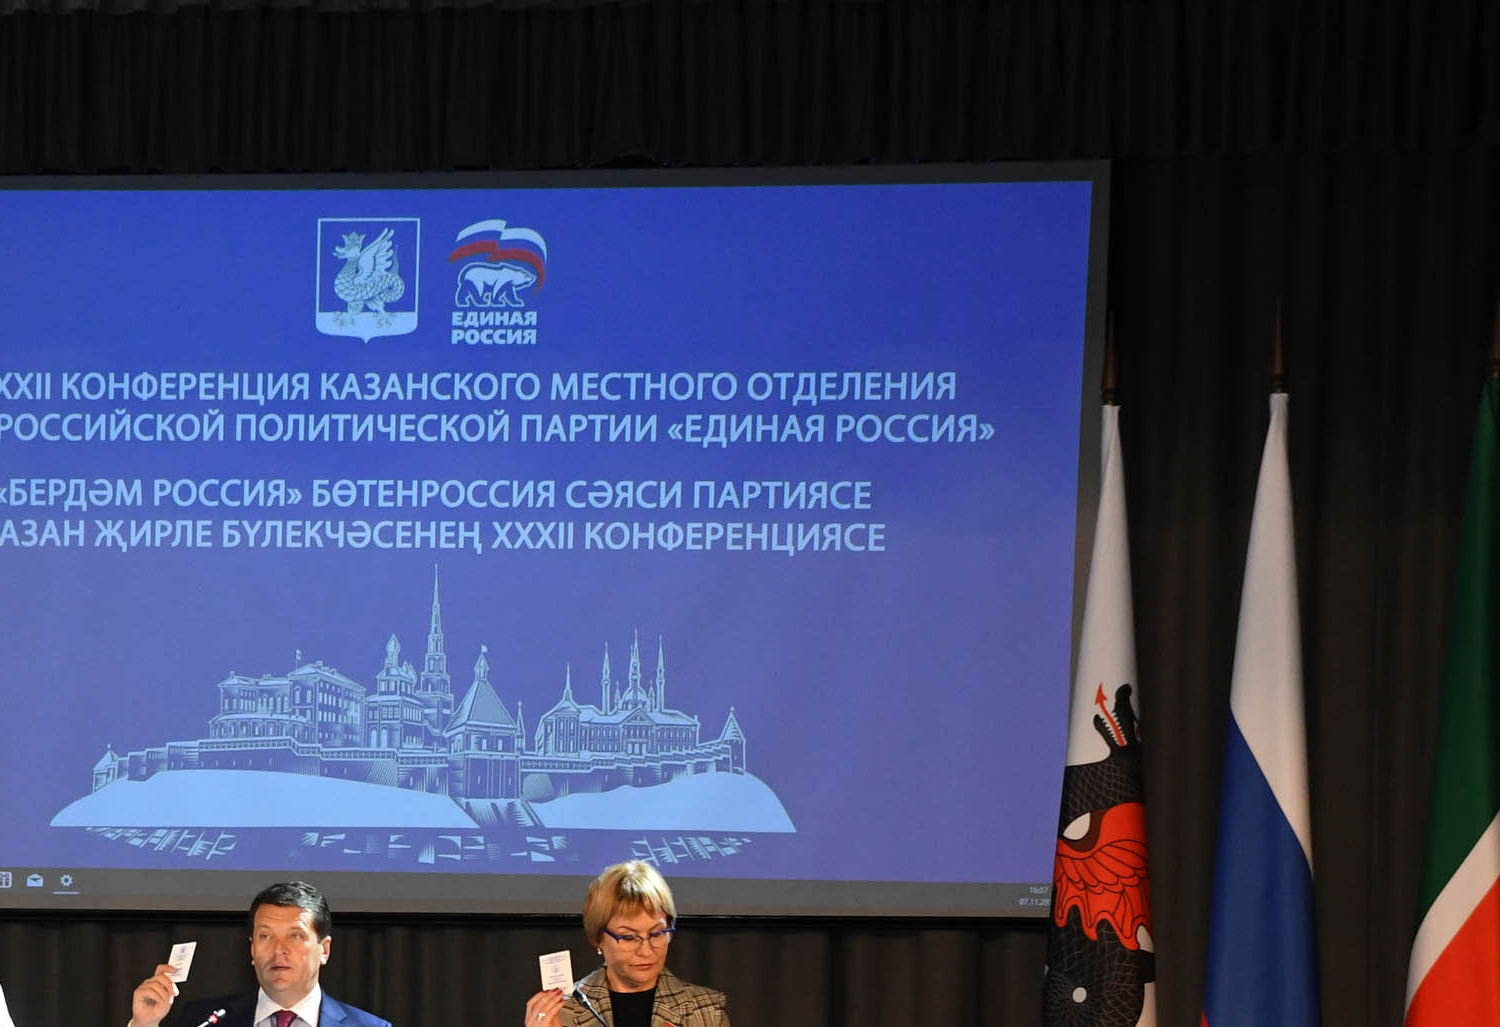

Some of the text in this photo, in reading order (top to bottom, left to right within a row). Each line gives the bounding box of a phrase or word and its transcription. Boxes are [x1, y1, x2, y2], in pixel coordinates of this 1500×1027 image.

[451, 310, 537, 327] ЕДИНАЯ
[451, 328, 537, 345] РОССИЯ
[62, 372, 309, 406] КОНФЕРЕНЦИЯ
[321, 373, 540, 400] КАЗАНСКОГО
[551, 373, 737, 400] МЕСТНОГО
[748, 372, 956, 406] ОТДЕЛЕНИЯ
[236, 409, 509, 442] ПОЛИТИЧЕСКОЙ
[521, 414, 657, 442] ПАРТИИ
[668, 414, 824, 448] «ЕДИНАЯ
[836, 415, 995, 442] РОССИЯ»
[154, 479, 302, 507] РОССИЯ»
[313, 479, 555, 508] БӨТЕНРОССИЯ
[566, 480, 682, 508] СӘЯСИ
[694, 481, 871, 509] ПАРТИЯСЕ
[94, 520, 212, 552] ҖИРЛЕ
[222, 520, 482, 555] БҮЛЕКЧӘСЕНЕҢ
[492, 522, 574, 549] XXXII
[585, 522, 885, 552] КОНФЕРЕНЦИЯСЕ
